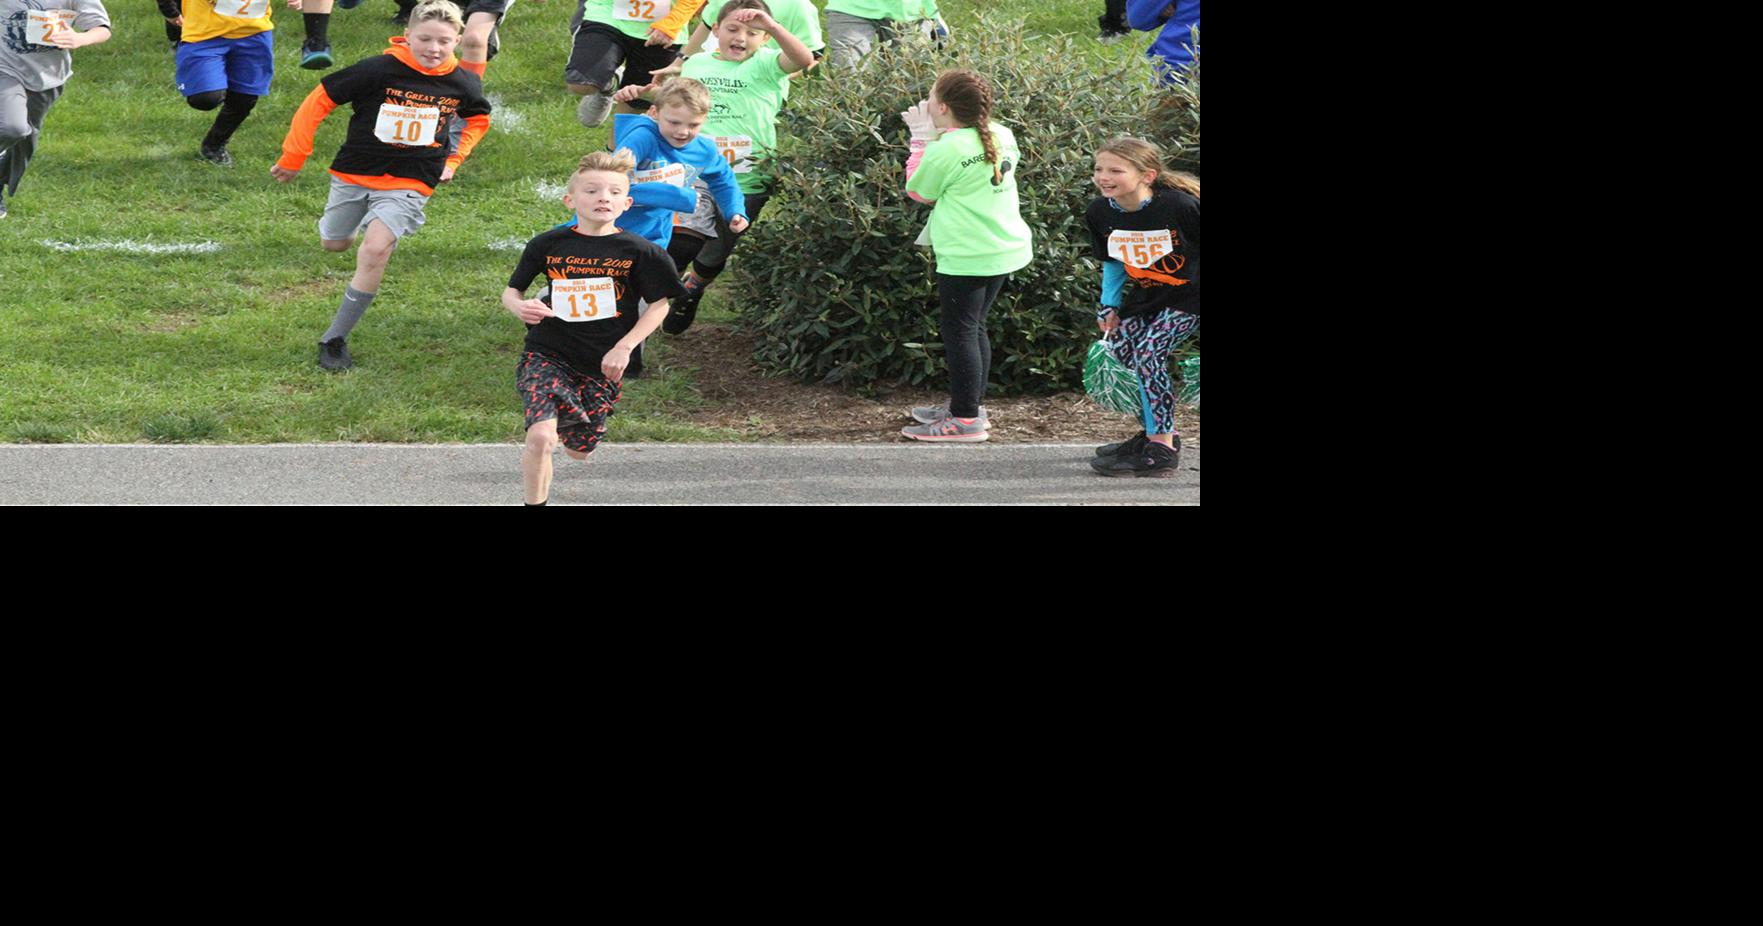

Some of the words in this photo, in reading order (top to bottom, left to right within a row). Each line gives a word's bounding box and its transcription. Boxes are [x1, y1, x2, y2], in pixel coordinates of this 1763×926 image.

[628, 0, 656, 19] 32
[385, 88, 403, 97] THE
[404, 91, 435, 102] GREAT
[381, 109, 416, 119] PUMPKIN
[393, 119, 422, 142] 10
[664, 168, 683, 178] RACE
[1118, 243, 1164, 265] 156
[546, 255, 563, 265] THE
[565, 256, 600, 265] GREAT
[602, 258, 633, 268] 2018
[566, 265, 605, 275] PUMPKIN
[606, 268, 630, 277] RACE
[554, 285, 588, 293] PUMPKIN
[589, 283, 612, 291] RACE
[567, 293, 599, 318] 13
